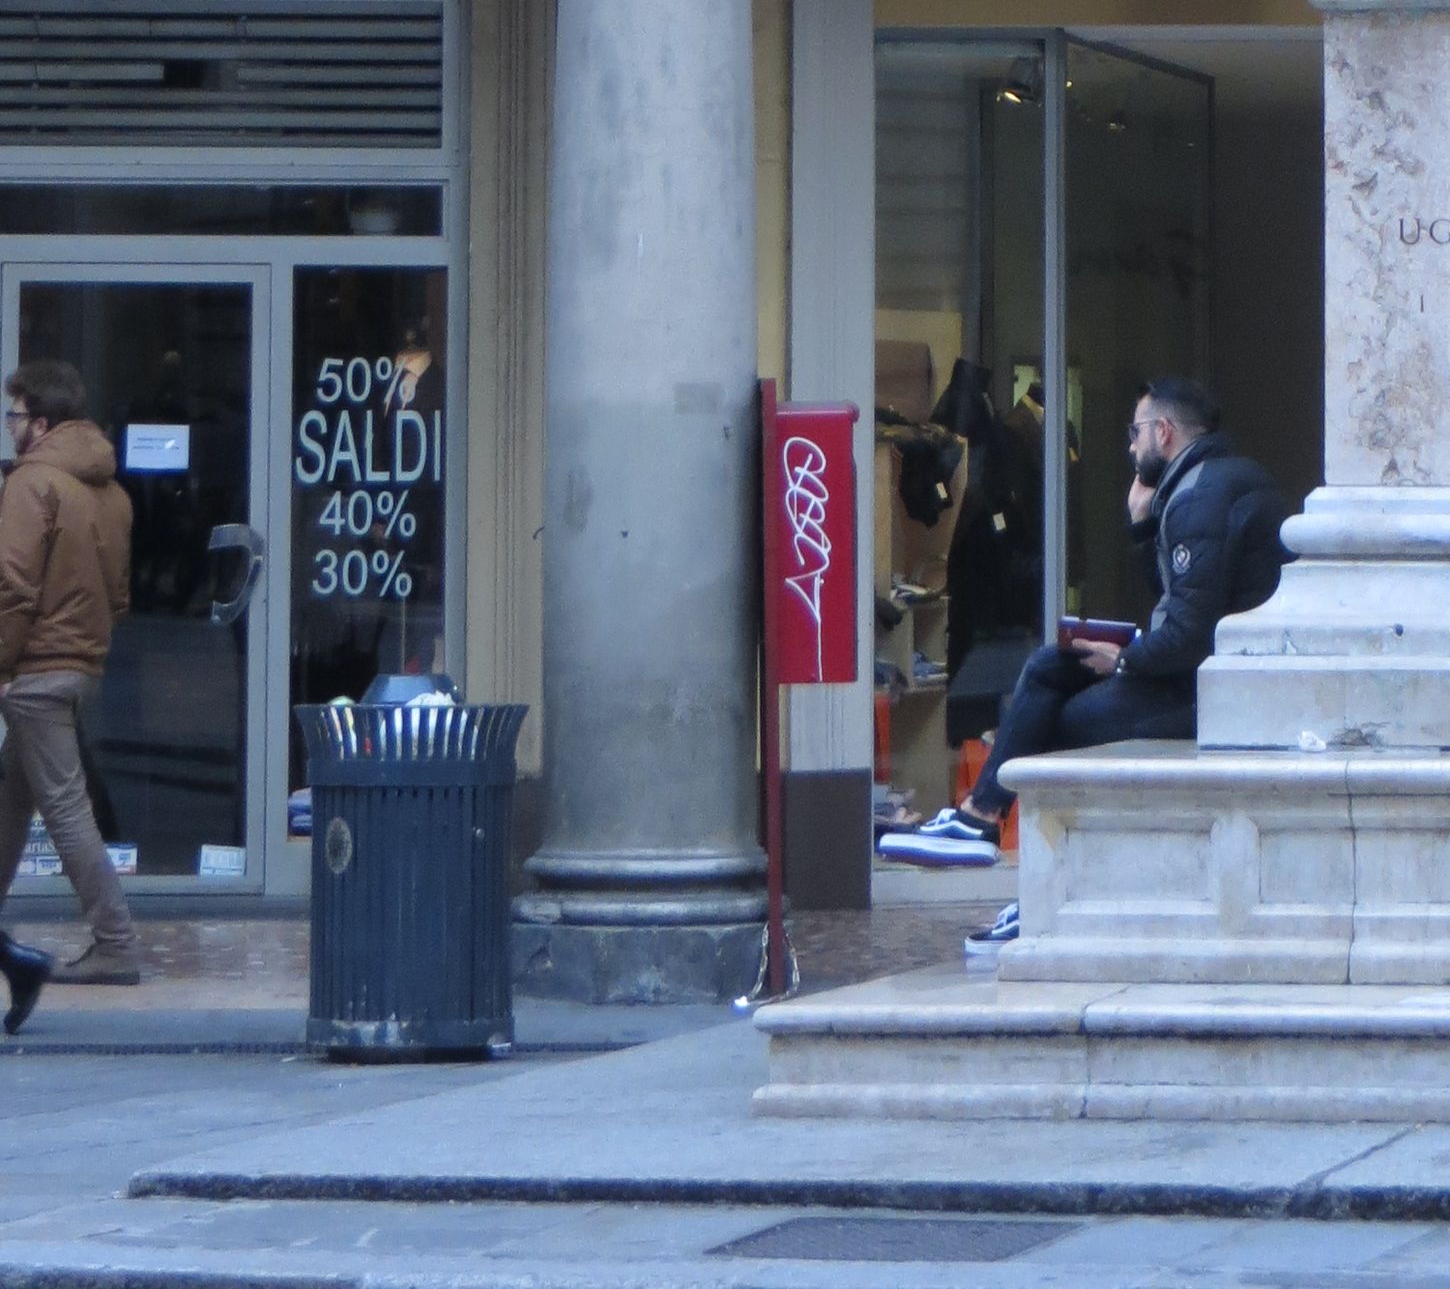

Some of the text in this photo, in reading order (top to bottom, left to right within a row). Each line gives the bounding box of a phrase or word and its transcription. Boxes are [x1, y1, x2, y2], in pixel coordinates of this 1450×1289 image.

[1419, 295, 1425, 313] I
[316, 356, 417, 403] 50%
[296, 410, 442, 484] SALDI
[319, 490, 417, 538] 40%
[312, 549, 413, 597] 30%
